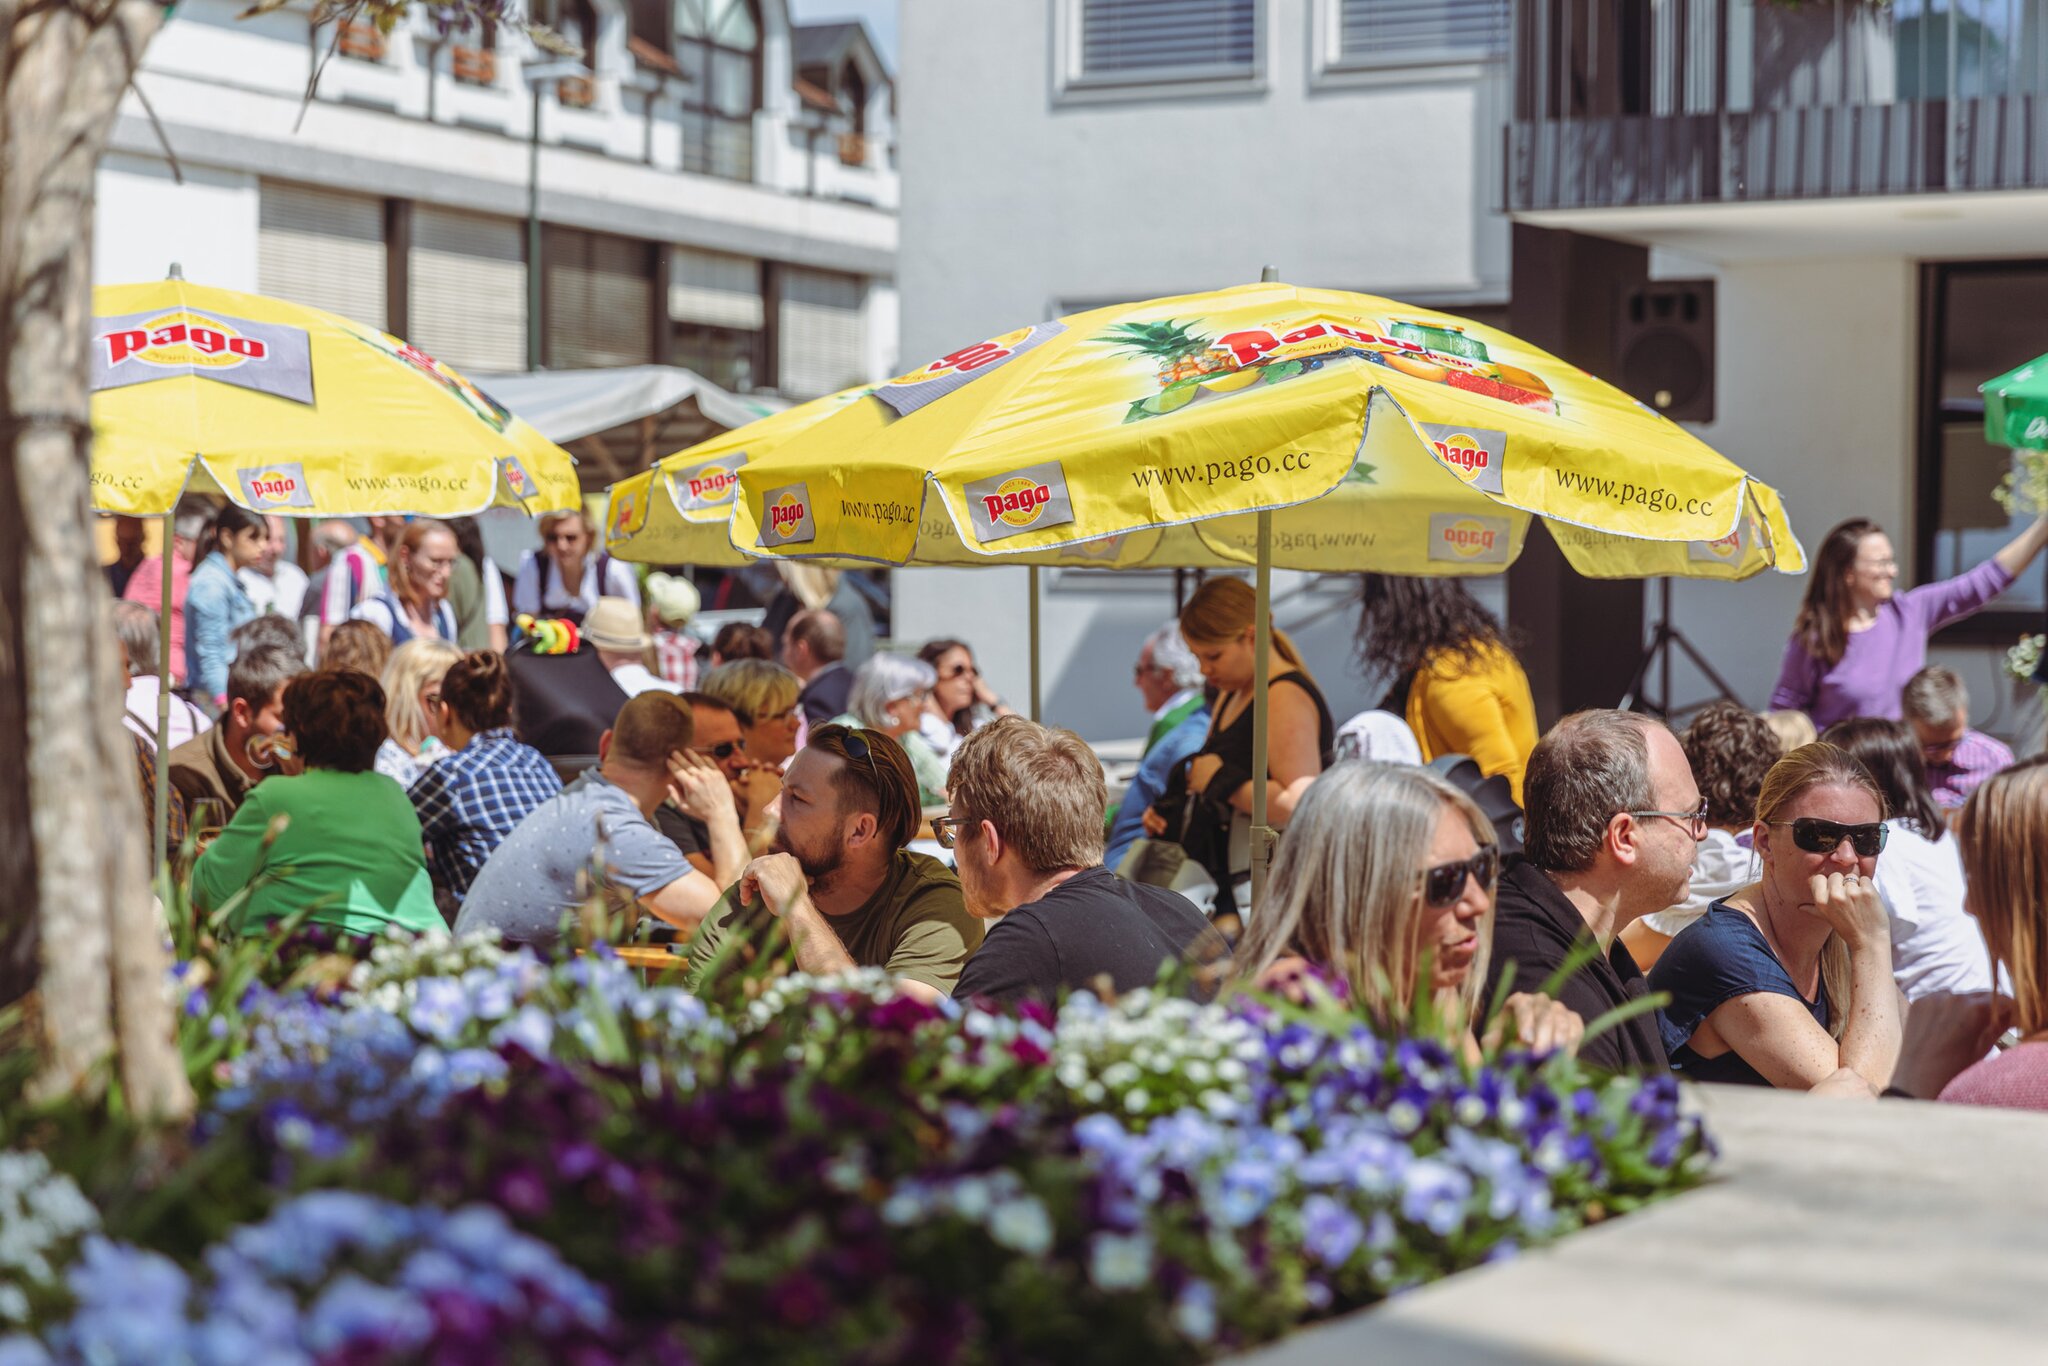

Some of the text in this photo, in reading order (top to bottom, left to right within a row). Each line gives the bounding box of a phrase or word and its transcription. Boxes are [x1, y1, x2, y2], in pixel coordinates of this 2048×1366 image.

[102, 323, 266, 364] pago
[1133, 452, 1311, 488] www.pago.cc
[251, 479, 296, 498] pago
[982, 485, 1050, 523] pago
[1556, 469, 1714, 516] www.pago.cc
[770, 502, 804, 531] pago
[841, 499, 915, 526] www.pago.cc
